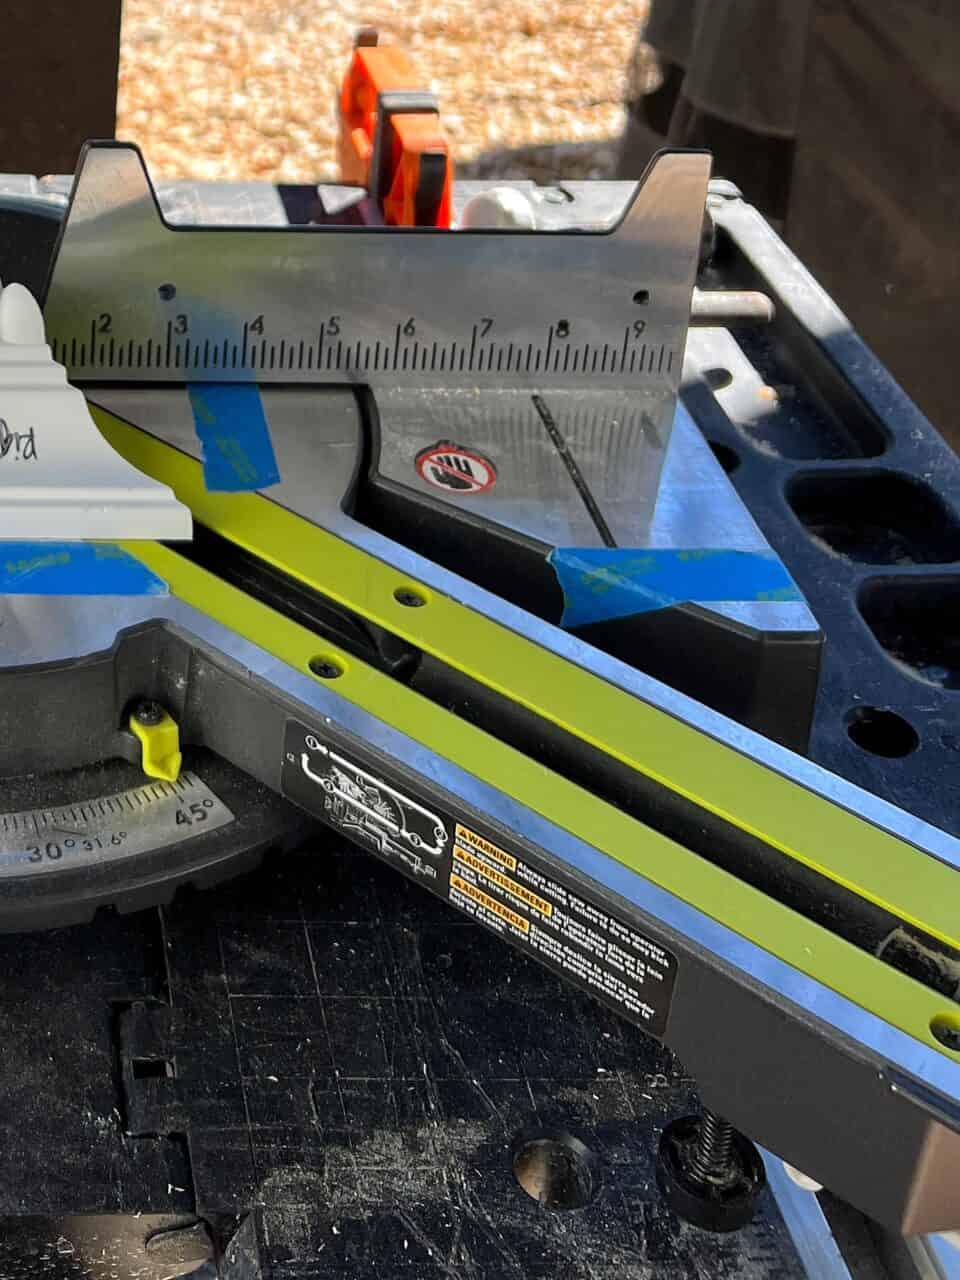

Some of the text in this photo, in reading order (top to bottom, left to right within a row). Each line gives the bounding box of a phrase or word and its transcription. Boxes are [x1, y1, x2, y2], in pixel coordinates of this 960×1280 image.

[98, 314, 645, 338] 2 3 4 5 6 7 8 9
[27, 838, 76, 863] 30°
[176, 799, 214, 827] 45°
[469, 835, 514, 868] WARNING
[462, 882, 525, 928] ADVERTENCIA
